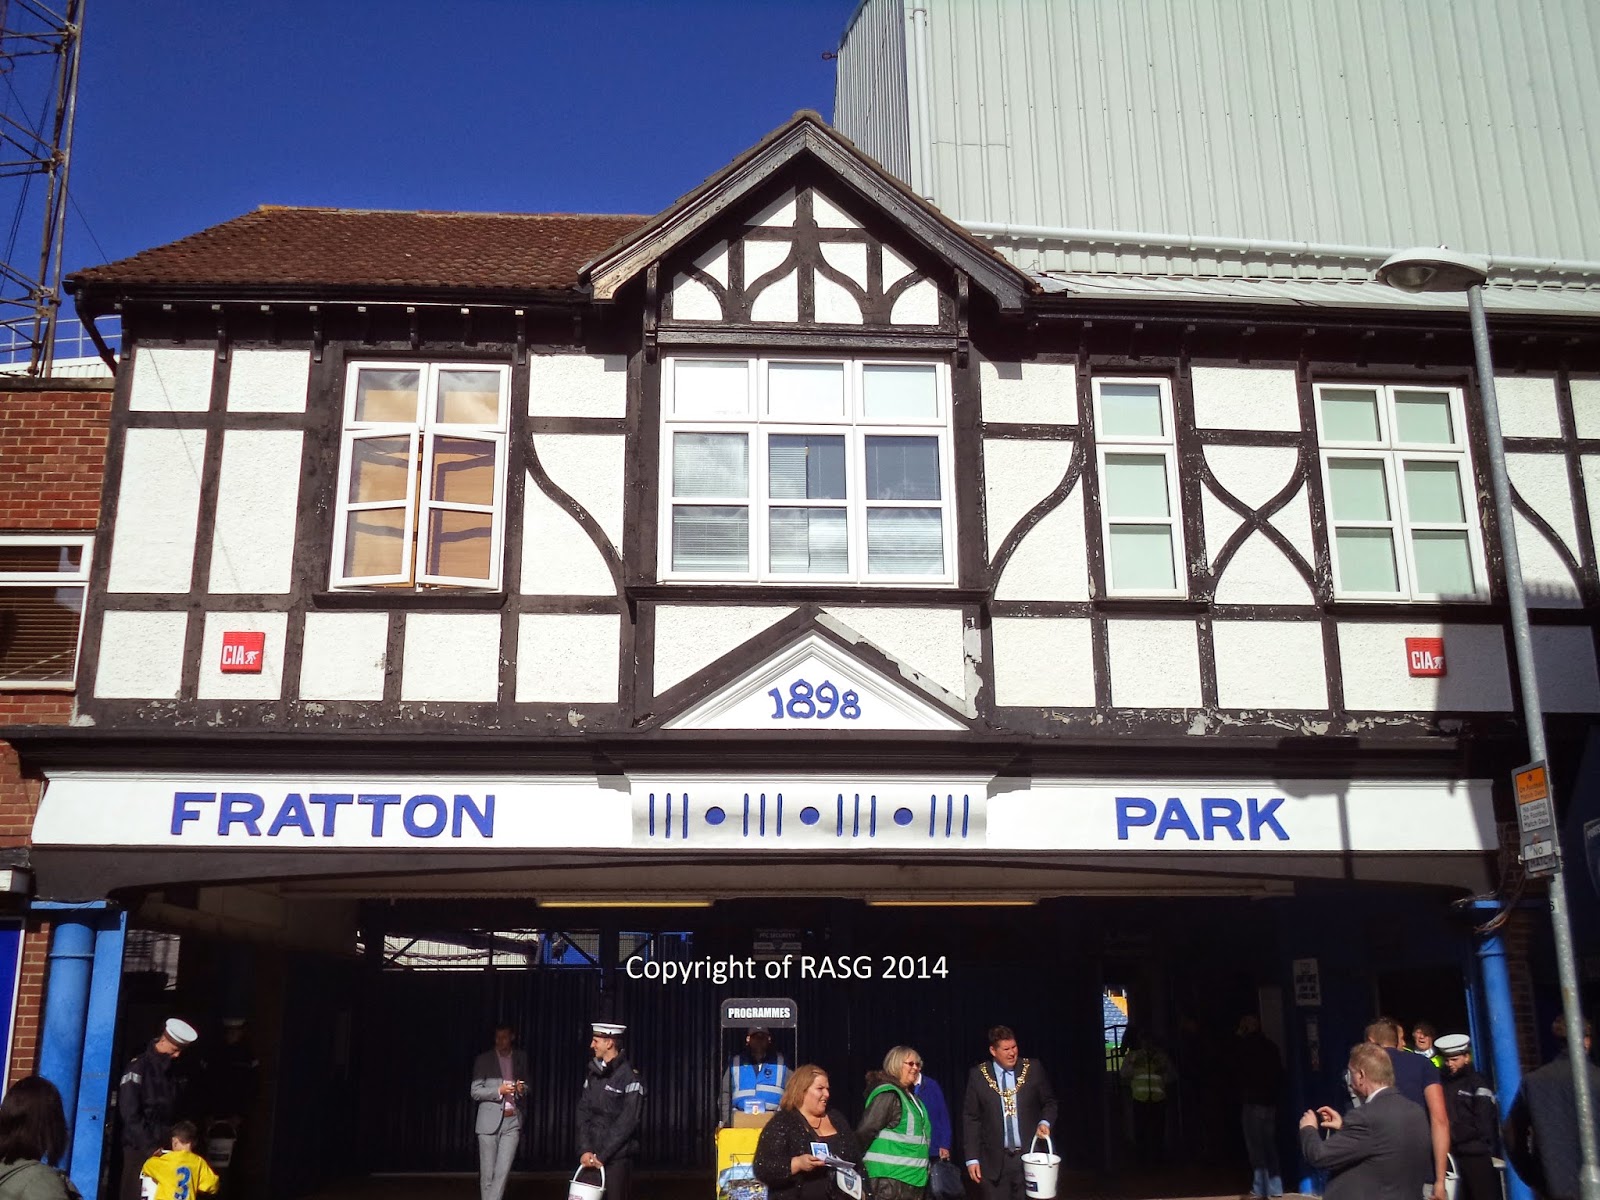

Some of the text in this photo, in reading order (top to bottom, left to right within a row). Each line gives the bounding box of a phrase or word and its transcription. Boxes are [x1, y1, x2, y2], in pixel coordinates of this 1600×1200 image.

[222, 645, 245, 665] CIA
[1411, 651, 1434, 669] CIA
[768, 679, 861, 719] 1898
[170, 791, 1290, 840] FRATTON PARK
[1533, 846, 1544, 855] NO
[728, 1007, 791, 1019] PROGRAMMES
[175, 1166, 191, 1200] 3
